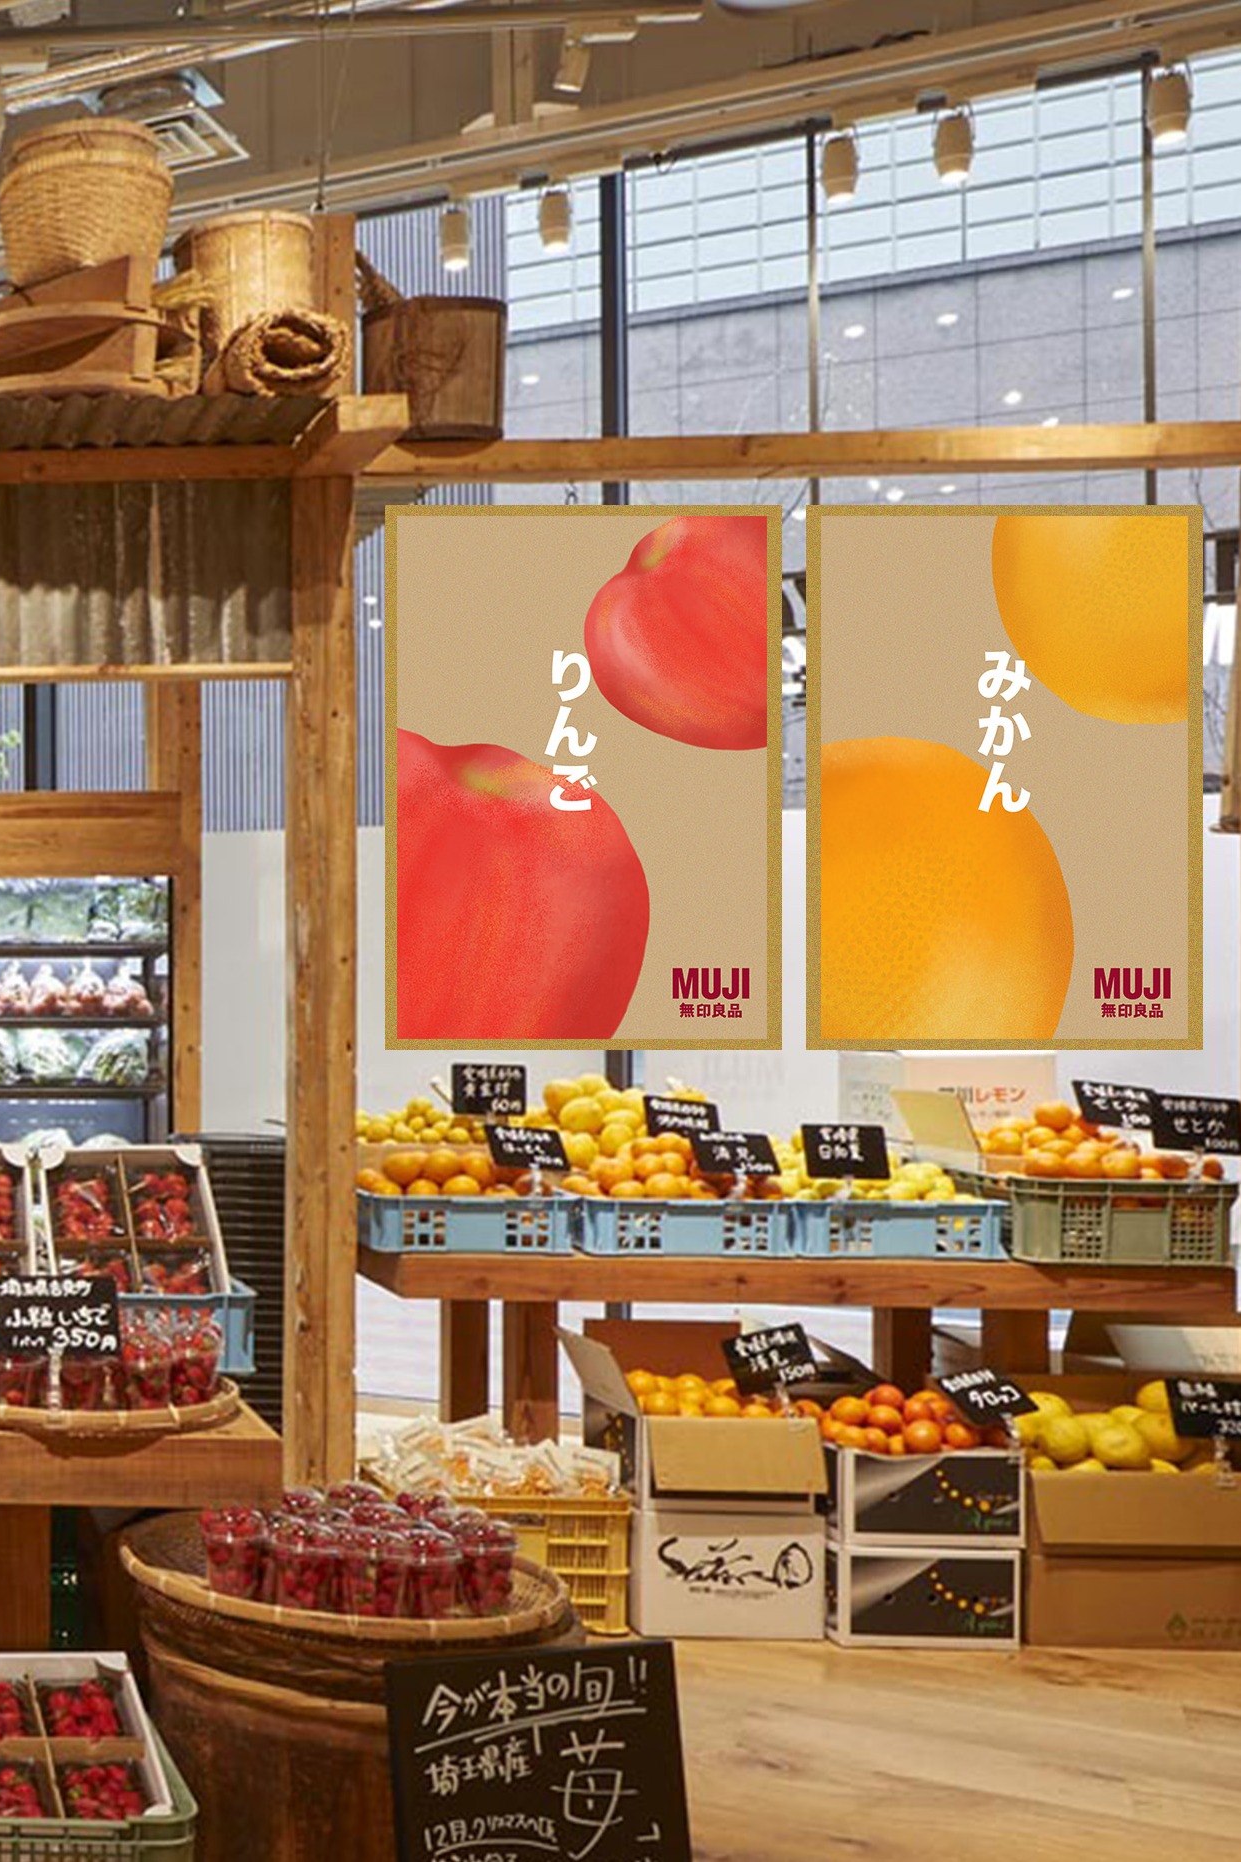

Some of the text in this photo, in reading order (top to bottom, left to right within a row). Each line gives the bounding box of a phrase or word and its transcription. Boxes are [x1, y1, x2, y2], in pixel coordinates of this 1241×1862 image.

[544, 650, 598, 812] りんご
[978, 650, 1032, 813] みかん
[672, 967, 750, 1000] MUJI
[1093, 967, 1171, 1000] MUJI
[678, 1003, 743, 1019] 無印良品
[1100, 1002, 1164, 1019] 無印良品
[1173, 1118, 1226, 1136] せとか
[52, 1326, 118, 1351] 350円
[424, 1735, 533, 1796] 埼玉県産
